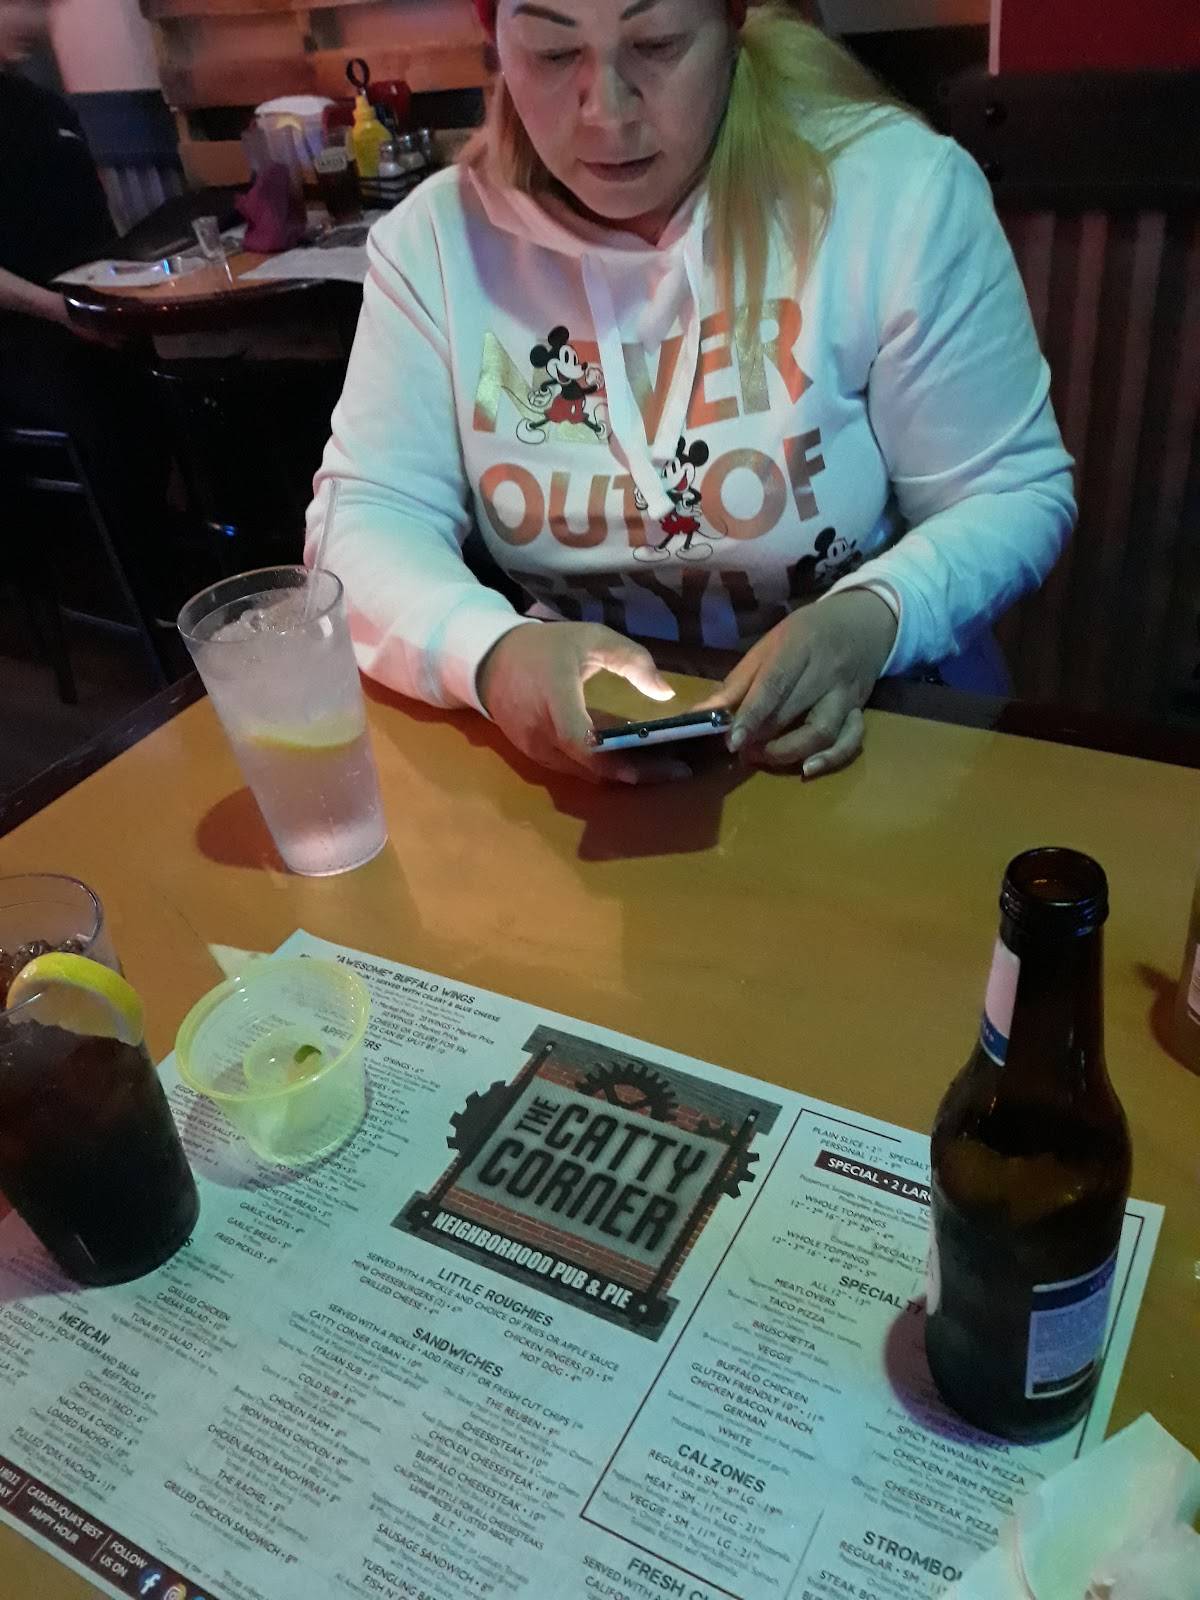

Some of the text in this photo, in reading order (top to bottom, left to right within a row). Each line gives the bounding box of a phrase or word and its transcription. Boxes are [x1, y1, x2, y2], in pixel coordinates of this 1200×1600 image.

[700, 428, 826, 540] OF
[392, 973, 438, 992] BUFFALO
[440, 988, 475, 1004] WINGS
[473, 1010, 500, 1021] CHEESE
[514, 1095, 707, 1194] THE CATTY
[827, 1158, 881, 1183] SPECIAL
[891, 1180, 899, 1189] 2
[477, 1138, 679, 1252] CORNER
[432, 1211, 633, 1309] NEIGHBORHOOD PUB & PIE
[366, 1252, 396, 1269] SERVED
[395, 1265, 418, 1279] WITH
[588, 1353, 618, 1372] SAUCE
[437, 1268, 553, 1326] LITTLE ROUGHIES
[768, 1296, 825, 1323] TACO PIZZA
[57, 1311, 111, 1345] MEXICAN
[308, 1309, 401, 1359] CATTY CORNER CUBAN
[327, 1303, 358, 1322] SERVED
[357, 1317, 381, 1332] WITH
[442, 1359, 466, 1374] FRIES
[492, 1383, 520, 1401] FRESH
[521, 1397, 541, 1411] CUT
[541, 1407, 570, 1425] CHIPS
[345, 1362, 363, 1374] SUB
[411, 1327, 504, 1377] SANDWICHES
[503, 1329, 581, 1370] CHICKEN FINGERS
[519, 1351, 563, 1375] HOT DOG
[756, 1344, 792, 1364] VEGGIE
[297, 1373, 339, 1398] COLD SUB
[690, 1362, 730, 1384] GLUTEN
[716, 1359, 808, 1404] BUFFALO CHICKEN
[484, 1396, 541, 1429] THE REUBEN
[690, 1375, 813, 1434] CHICKEN BACON RANCH
[723, 1403, 767, 1428] GERMAN
[291, 1433, 331, 1459] CHICKEN
[461, 1421, 524, 1457] CHEESESTEAK
[717, 1426, 752, 1447] WHITE
[216, 1470, 268, 1504] THE RACHEL
[469, 1452, 534, 1489] CHEESESTEAK
[648, 1449, 696, 1477] REGULAR
[703, 1476, 718, 1488] SM
[676, 1443, 766, 1494] CALZONES
[893, 1448, 943, 1475] CHICKEN
[980, 1485, 1014, 1506] PIZZA
[991, 1465, 1025, 1486] PIZZA
[456, 1472, 521, 1511] CHEESESTEAK
[884, 1479, 999, 1537] CHEESESTEAK PIZZA
[27, 1504, 81, 1544] HAPPY HOUR
[163, 1480, 282, 1556] GRILLED CHICKEN SANDWICH
[673, 1514, 689, 1528] SM
[100, 1553, 129, 1578] US ON
[110, 1539, 149, 1569] FOLLOW
[376, 1523, 475, 1584] SAUSAGE SANDWICH
[839, 1540, 893, 1572] REGULAR
[362, 1574, 385, 1593] FISH
[582, 1556, 653, 1600] SERVED WITH
[627, 1557, 685, 1597] FRESH
